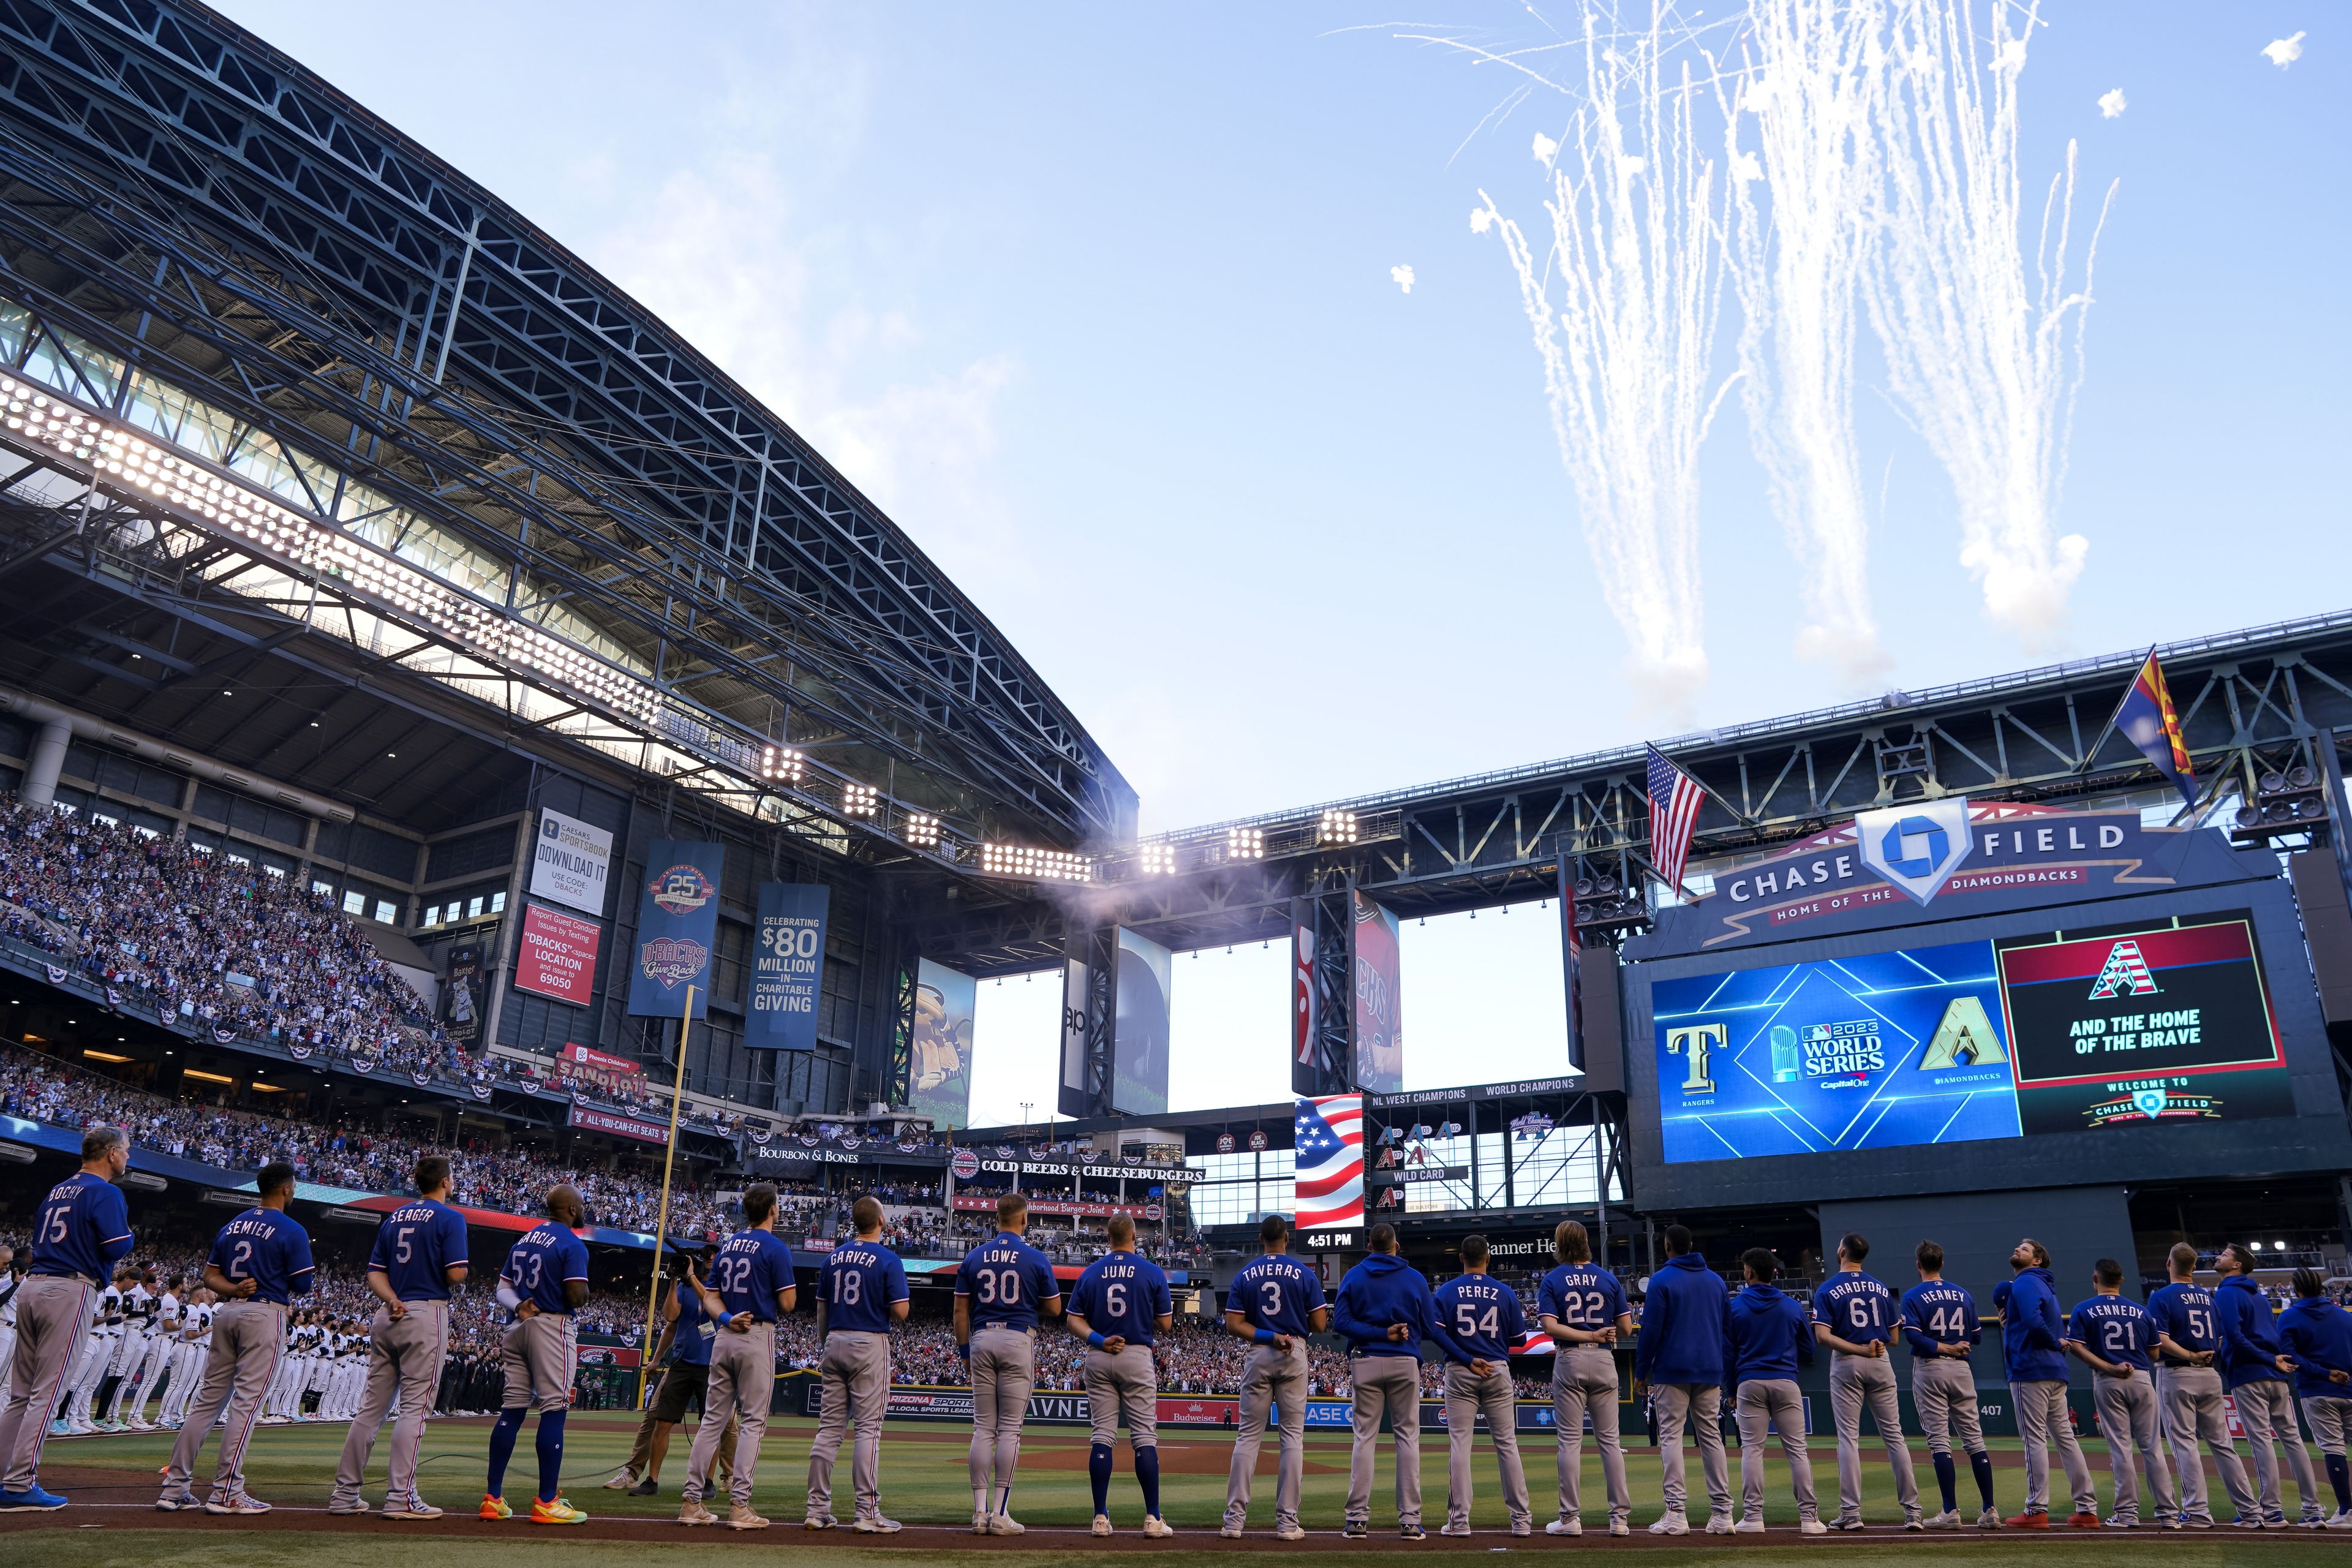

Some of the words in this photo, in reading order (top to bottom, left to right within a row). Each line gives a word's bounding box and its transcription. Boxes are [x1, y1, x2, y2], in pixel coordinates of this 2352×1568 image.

[561, 825, 590, 840] CAESARS
[560, 832, 608, 858] SPORTSBOOK
[538, 844, 593, 877] DOWNLOAD
[596, 865, 605, 881] IT
[1730, 855, 1853, 903] CHASE
[1984, 826, 2124, 856] FIELD
[552, 872, 565, 881] USE
[567, 877, 588, 889] CODE:
[663, 866, 688, 878] ARIZONA
[691, 868, 704, 880] BORN
[555, 882, 582, 896] DBACKS
[668, 875, 696, 897] 25
[657, 895, 704, 904] ANNIVERSARY
[1777, 903, 1820, 921] HOME
[1831, 897, 1850, 909] OF
[1862, 889, 1892, 903] THE
[1952, 870, 2078, 889] DIAMONDBACKS
[532, 908, 552, 921] Report
[554, 916, 571, 927] Guest
[573, 922, 598, 935] Conduct
[764, 917, 819, 927] CELEBRATING
[538, 920, 557, 932] Issues
[559, 927, 566, 937] by
[568, 930, 590, 944] Texting
[762, 927, 818, 958] $80
[535, 949, 582, 971] LOCATION
[758, 958, 816, 973] MILLION
[454, 965, 475, 977] Baxter
[552, 966, 567, 975] issue
[646, 962, 669, 977] Give
[667, 963, 698, 979] Back
[780, 974, 790, 982] IN
[540, 973, 571, 989] 69050
[756, 984, 813, 995] CHARITABLE
[755, 995, 812, 1012] GIVING
[1833, 1022, 1879, 1035] 2023
[2070, 1019, 2106, 1036] AND
[2111, 1014, 2144, 1032] THE
[2149, 1009, 2199, 1029] HOME
[1803, 1035, 1882, 1058] WORLD
[2075, 1038, 2098, 1054] OF
[2102, 1034, 2136, 1051] THE
[2141, 1028, 2201, 1048] BRAVE
[589, 1054, 607, 1063] Phoenix
[608, 1058, 629, 1068] Children's
[1805, 1052, 1885, 1076] SERIES
[559, 1061, 642, 1092] SANDLOT
[1934, 1072, 2001, 1084] DIAMONDBACKS
[2107, 1079, 2166, 1092] WELCOME
[2173, 1077, 2188, 1086] TO
[1486, 1085, 1517, 1096] WORLD
[1519, 1079, 1575, 1093] CHAMPIONS
[1373, 1097, 1384, 1106] NL
[1386, 1095, 1411, 1104] WEST
[1413, 1089, 1466, 1102] CHAMPIONS
[1683, 1099, 1714, 1107] RANGERS
[2095, 1103, 2133, 1115] CHASE
[587, 1115, 640, 1133] ALL-YOU-CAN-EAT
[641, 1126, 659, 1138] SEATS
[1510, 1116, 1527, 1127] World
[1526, 1115, 1554, 1125] Champions
[812, 1150, 822, 1161] &
[981, 1160, 1019, 1172] COLD
[1022, 1163, 1068, 1175] BEERS
[1071, 1166, 1080, 1176] &
[1082, 1166, 1204, 1182] CHEESEBURGERS
[1394, 1170, 1417, 1182] WILD
[1420, 1169, 1444, 1180] CARD
[48, 1185, 84, 1202] BOCHY
[390, 1210, 434, 1224] SEAGER
[1060, 1204, 1085, 1213] Burger
[1087, 1204, 1106, 1213] Joint
[39, 1205, 70, 1244] 15
[226, 1219, 276, 1241] SEMIEN
[395, 1227, 416, 1264] 5
[720, 1239, 761, 1255] CARTER
[1308, 1235, 1330, 1246] 4:51
[1335, 1234, 1352, 1246] PM
[230, 1241, 252, 1278] 2
[831, 1251, 876, 1268] GARVER
[984, 1250, 1020, 1264] LOWE
[512, 1251, 542, 1289] 53
[718, 1257, 752, 1294] 32
[1101, 1265, 1136, 1278] JUNG
[1243, 1264, 1302, 1282] TAVERAS
[832, 1269, 861, 1305] 18
[978, 1269, 1020, 1304] 30
[1565, 1274, 1598, 1287] GRAY
[1261, 1281, 1281, 1316] 3
[1457, 1285, 1499, 1301] PEREZ
[1828, 1281, 1890, 1300] BRADFORD
[1920, 1289, 1966, 1305] HEANEY
[1106, 1283, 1128, 1317] 6
[1564, 1291, 1605, 1324] 22
[2180, 1293, 2211, 1306] SMITH
[1456, 1303, 1499, 1339] 54
[1849, 1297, 1881, 1329] 61
[1929, 1306, 1966, 1336] 44
[2087, 1305, 2144, 1320] KENNEDY
[2188, 1309, 2215, 1340] 51
[2105, 1321, 2136, 1351] 21
[1174, 1412, 1217, 1422] Budweiser
[1305, 1408, 1341, 1420] ASE
[1981, 1406, 2002, 1416] 407
